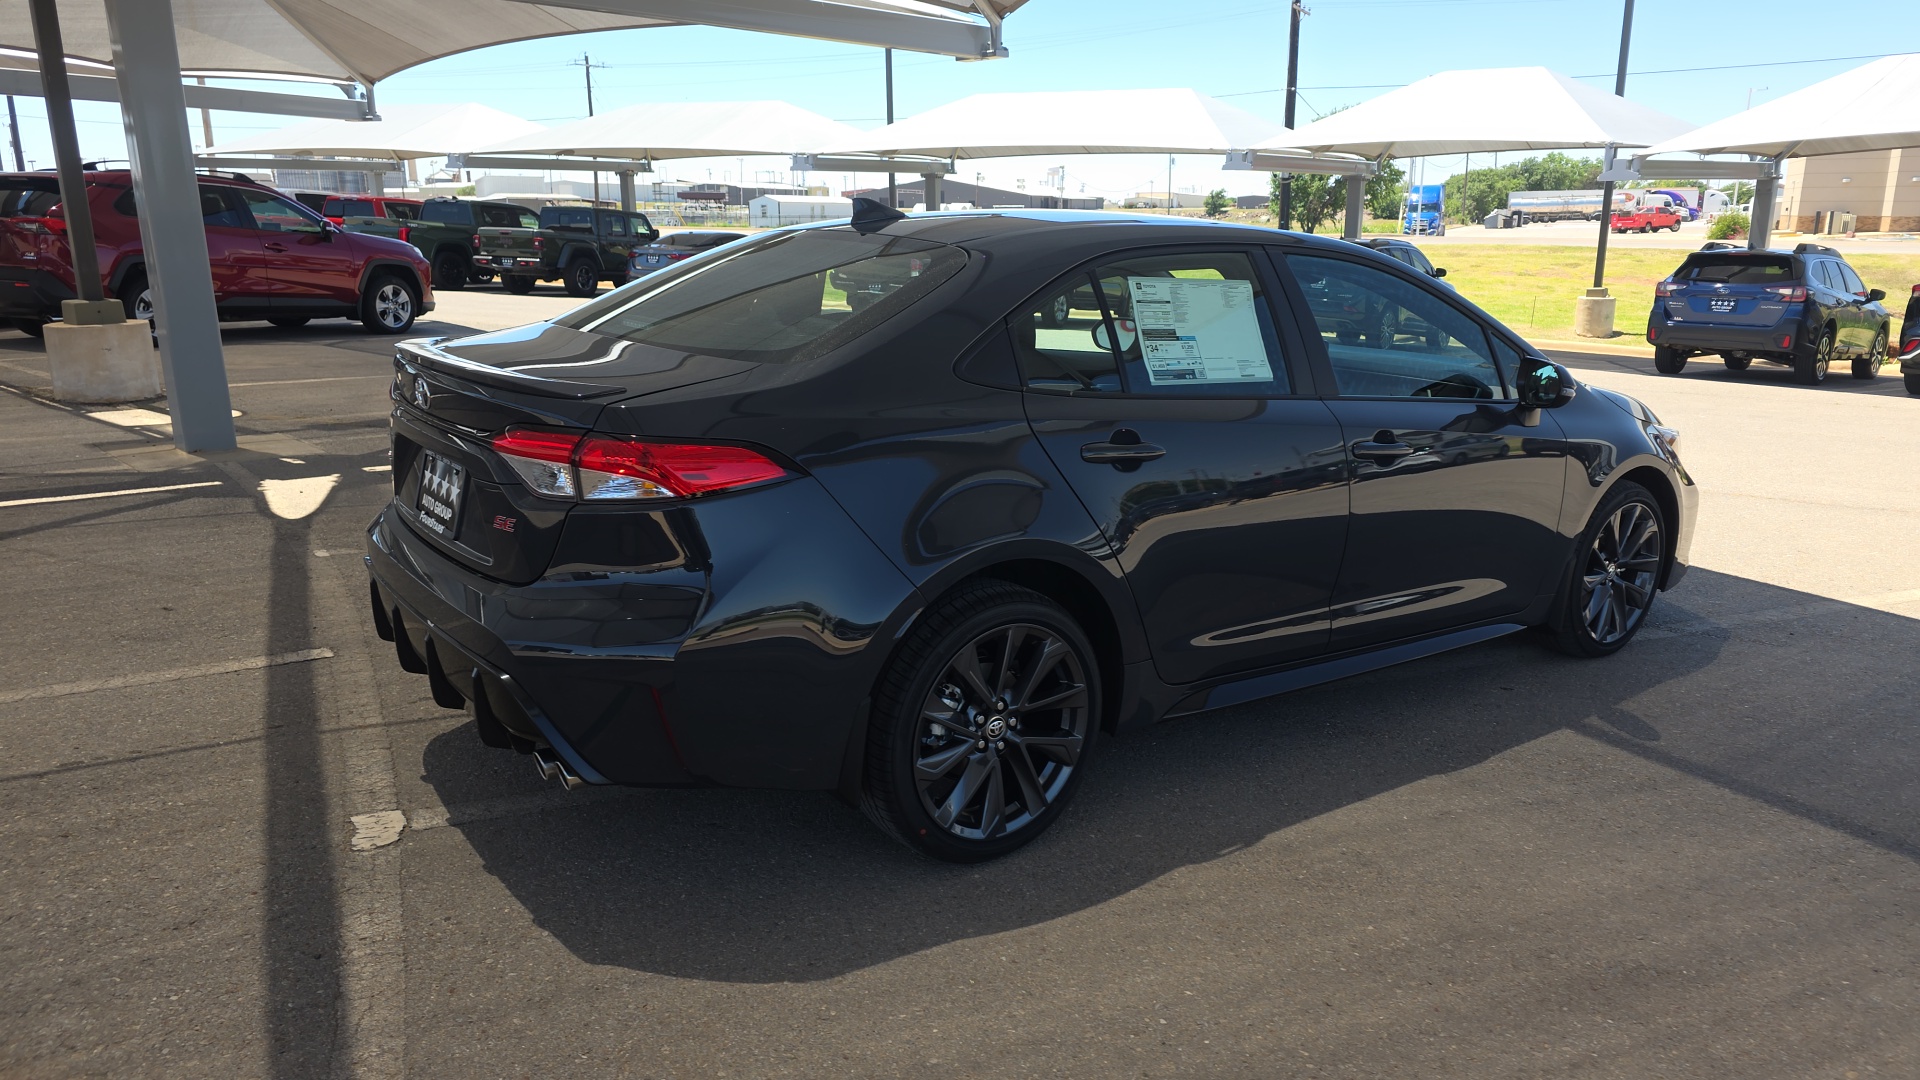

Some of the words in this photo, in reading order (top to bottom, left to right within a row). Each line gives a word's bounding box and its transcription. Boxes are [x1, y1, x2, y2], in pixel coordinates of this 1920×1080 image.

[1150, 344, 1159, 352] 34
[422, 493, 435, 510] AUTO
[434, 501, 453, 521] GROUP
[493, 515, 517, 533] SE
